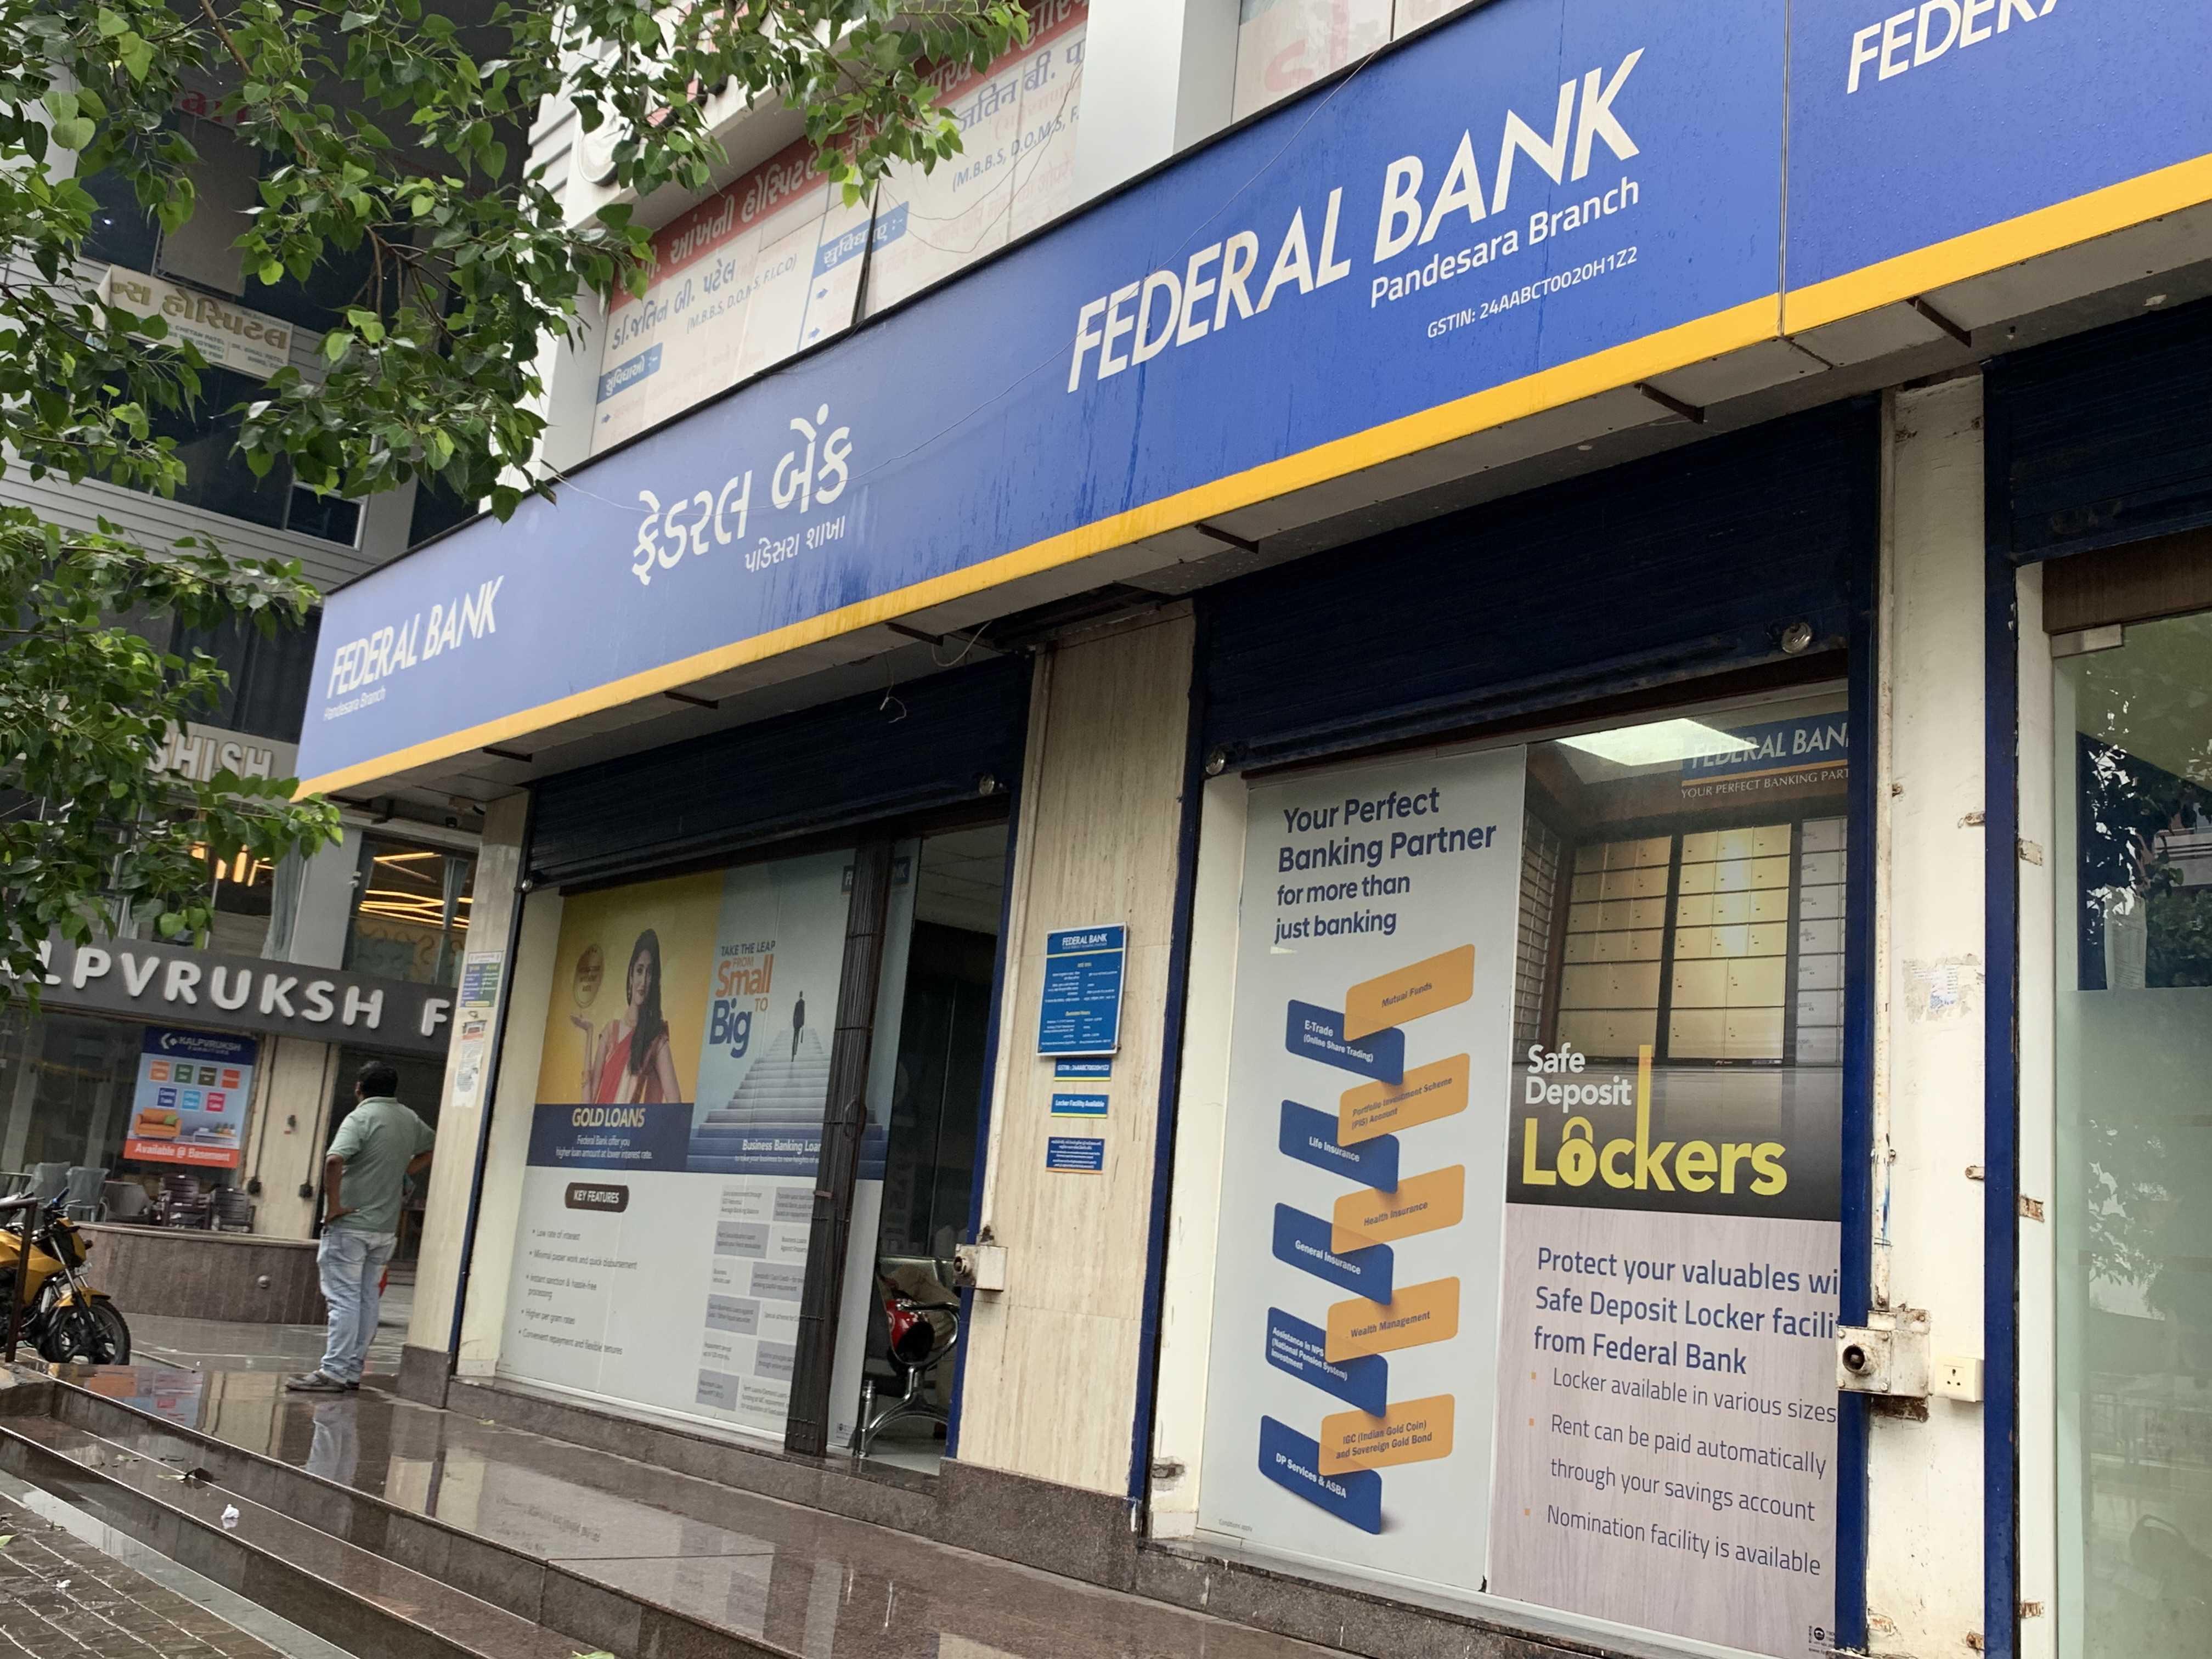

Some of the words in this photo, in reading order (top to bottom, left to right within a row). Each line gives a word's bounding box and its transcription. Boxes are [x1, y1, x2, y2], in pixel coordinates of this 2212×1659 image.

[1847, 0, 2057, 94] FEDER
[1067, 186, 1351, 393] FEDERAL
[1373, 47, 1645, 264] BANK
[1372, 230, 1519, 309] Pandesara
[1528, 176, 1639, 246] Branch
[1427, 310, 1476, 338] GSTIN:
[806, 515, 846, 550] શાખા
[326, 613, 421, 699] FEDERAL
[422, 575, 505, 661] BANK
[1793, 722, 1848, 754] BAN
[126, 732, 273, 783] SHISH
[1681, 785, 1713, 799] YOUR
[1715, 778, 1761, 794] PERFECT
[1763, 771, 1818, 788] BANKING
[1820, 768, 1849, 783] PART
[1283, 804, 1339, 833] Your
[1344, 787, 1440, 825] Perfect
[1278, 837, 1383, 872] Banking
[1390, 825, 1497, 859] Partner
[1277, 884, 1304, 906] for
[1306, 882, 1358, 904] more
[1362, 874, 1410, 897] than
[1062, 935, 1088, 946] FEDERAL
[1088, 933, 1108, 944] BANK
[1274, 917, 1310, 944] just
[1313, 909, 1397, 937] banking
[721, 945, 740, 957] TAKE
[741, 943, 755, 955] THE
[756, 940, 776, 954] LEAP
[732, 956, 754, 968] FROM
[715, 953, 774, 998] Small
[754, 997, 769, 1011] TO
[1381, 992, 1408, 1008] Mutual
[1409, 982, 1432, 998] Funds
[709, 996, 753, 1059] Big
[1304, 1019, 1334, 1037] E-Trade
[1304, 1034, 1325, 1048] (Online
[1327, 1040, 1346, 1054] Share
[1346, 1046, 1374, 1063] Trading)
[1527, 1042, 1585, 1074] Safe
[1351, 1101, 1381, 1118] Portfolio
[1423, 1077, 1453, 1093] Scheme
[1525, 1075, 1632, 1114] Deposit
[572, 1108, 603, 1127] GOLD
[605, 1107, 646, 1128] LOANS
[1369, 1108, 1398, 1124] Account
[134, 1143, 174, 1156] Available
[742, 1139, 772, 1151] Business
[774, 1139, 803, 1155] Banking
[1308, 1136, 1323, 1150] Life
[1324, 1141, 1361, 1163] Insurance
[573, 1189, 587, 1201] KEY
[587, 1190, 620, 1204] FEATURES
[1363, 1212, 1389, 1227] Health
[1390, 1201, 1429, 1219] Insurance
[1295, 1239, 1324, 1259] General
[1324, 1250, 1361, 1275] Insurance
[1538, 1247, 1618, 1277] Protect
[1624, 1259, 1676, 1284] your
[1683, 1259, 1800, 1293] valuables
[1808, 1268, 1838, 1296] wi
[1350, 1323, 1378, 1339] Wealth
[1379, 1311, 1431, 1330] Management
[1536, 1286, 1583, 1313] Safe
[1590, 1291, 1678, 1325] Deposit
[1685, 1300, 1765, 1331] Locker
[1773, 1307, 1839, 1339] facili
[1534, 1325, 1585, 1355] from
[1593, 1333, 1678, 1367] Federal
[1686, 1343, 1747, 1375] Bank
[1553, 1367, 1607, 1392] Locker
[1611, 1378, 1687, 1403] available
[1692, 1385, 1708, 1407] in
[1714, 1391, 1782, 1417] various
[1787, 1398, 1837, 1424] sizes
[1386, 1423, 1405, 1436] Gold
[1406, 1419, 1427, 1433] Coin)
[1335, 1448, 1351, 1460] and
[1352, 1442, 1390, 1459] Sovereign
[1392, 1436, 1410, 1449] Gold
[1411, 1432, 1432, 1445] Bond
[1551, 1414, 1590, 1438] Rent
[1594, 1425, 1623, 1443] can
[1629, 1425, 1649, 1447] be
[1655, 1432, 1691, 1454] paid
[1697, 1438, 1827, 1480] automatically
[1276, 1452, 1287, 1465] DP
[1287, 1458, 1317, 1483] Services
[1317, 1475, 1325, 1487] &
[1325, 1479, 1347, 1498] ASBA
[1551, 1458, 1616, 1491] through
[1621, 1472, 1660, 1494] your
[1664, 1481, 1733, 1512] savings
[1739, 1493, 1816, 1522] account
[1548, 1504, 1645, 1542] Nomination
[1651, 1523, 1710, 1559] facility
[1715, 1536, 1730, 1558] is
[1735, 1543, 1821, 1576] available
